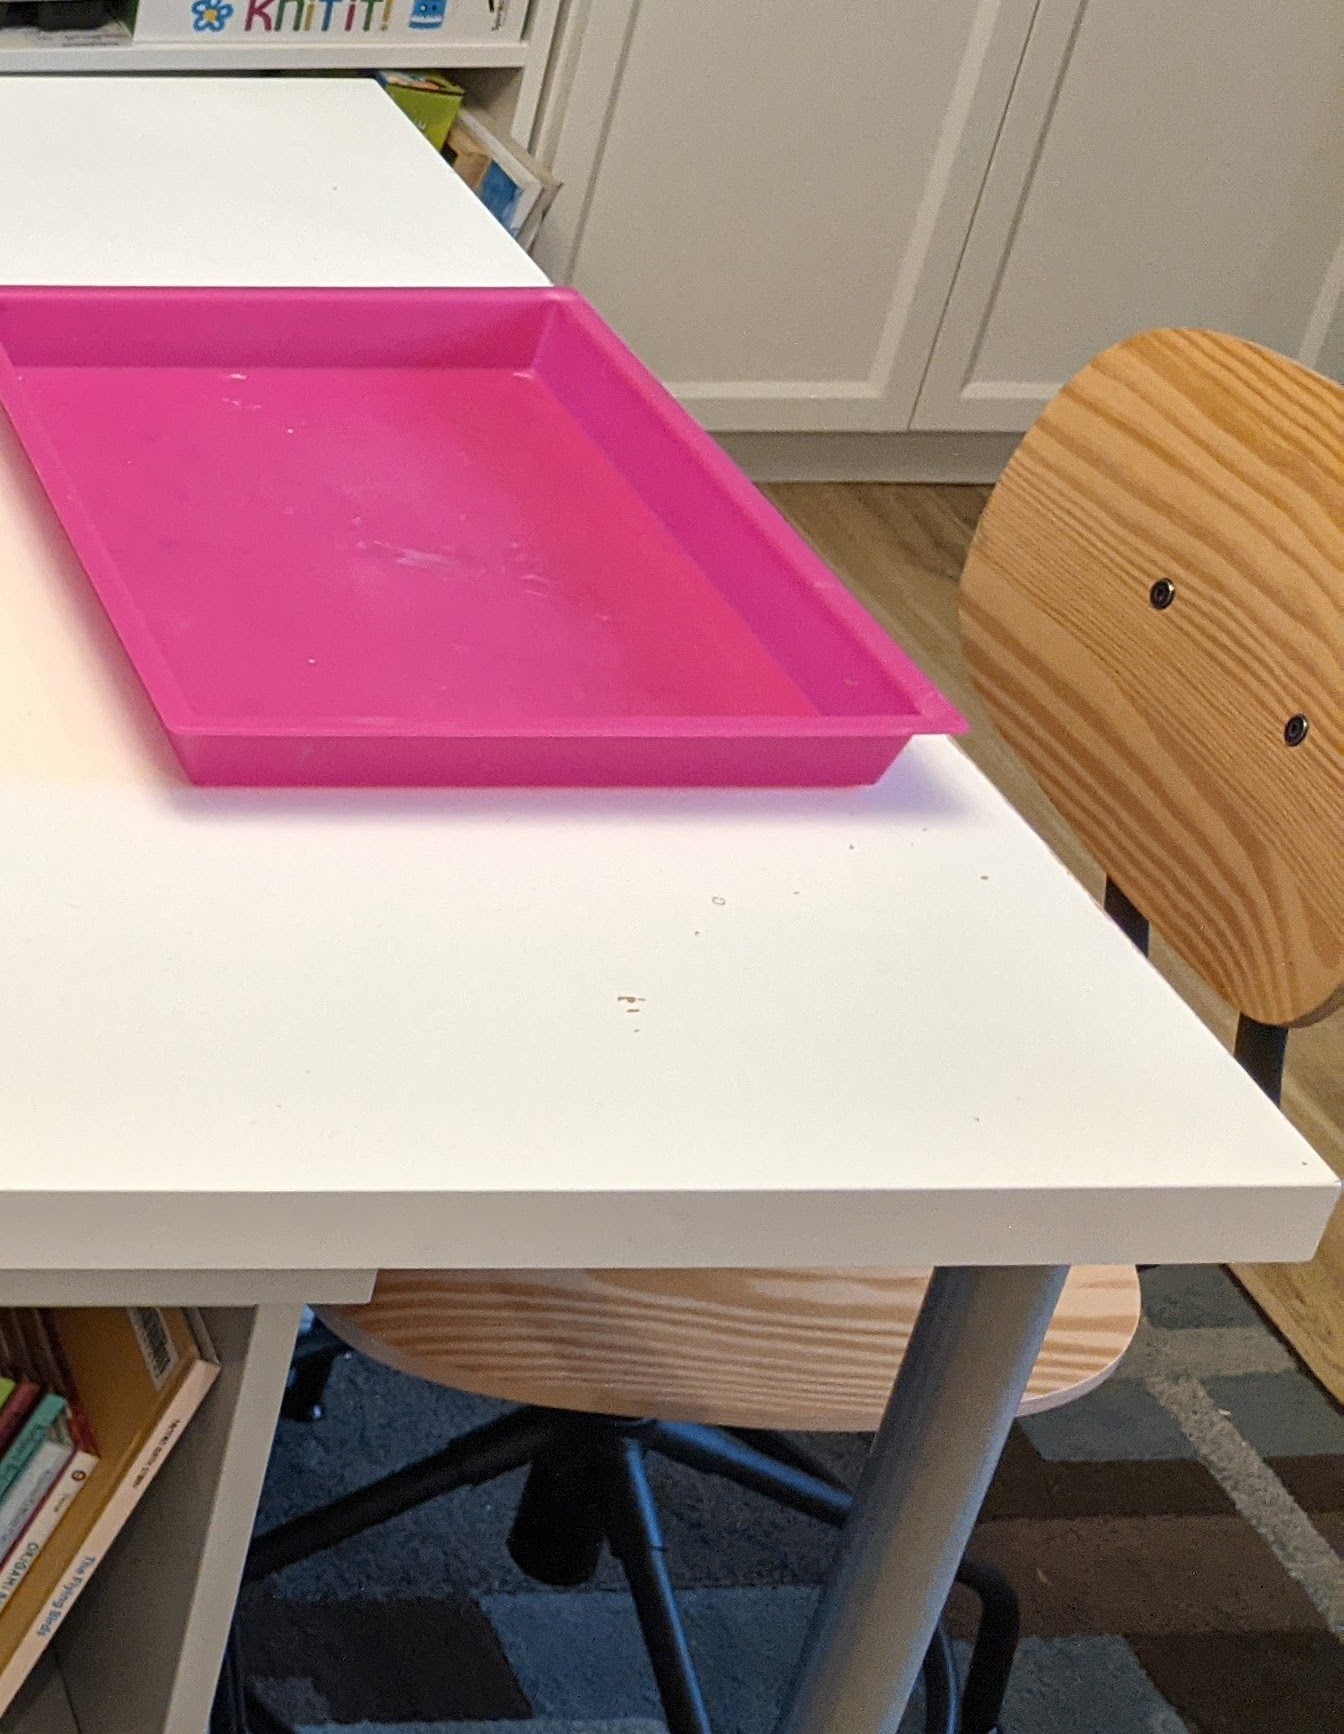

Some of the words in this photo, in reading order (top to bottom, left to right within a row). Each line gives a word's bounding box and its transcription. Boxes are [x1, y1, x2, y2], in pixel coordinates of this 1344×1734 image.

[1, 1542, 39, 1590] ORIGAMI
[75, 1554, 95, 1577] The
[53, 1574, 81, 1608] Flying
[37, 1608, 61, 1638] Birds
